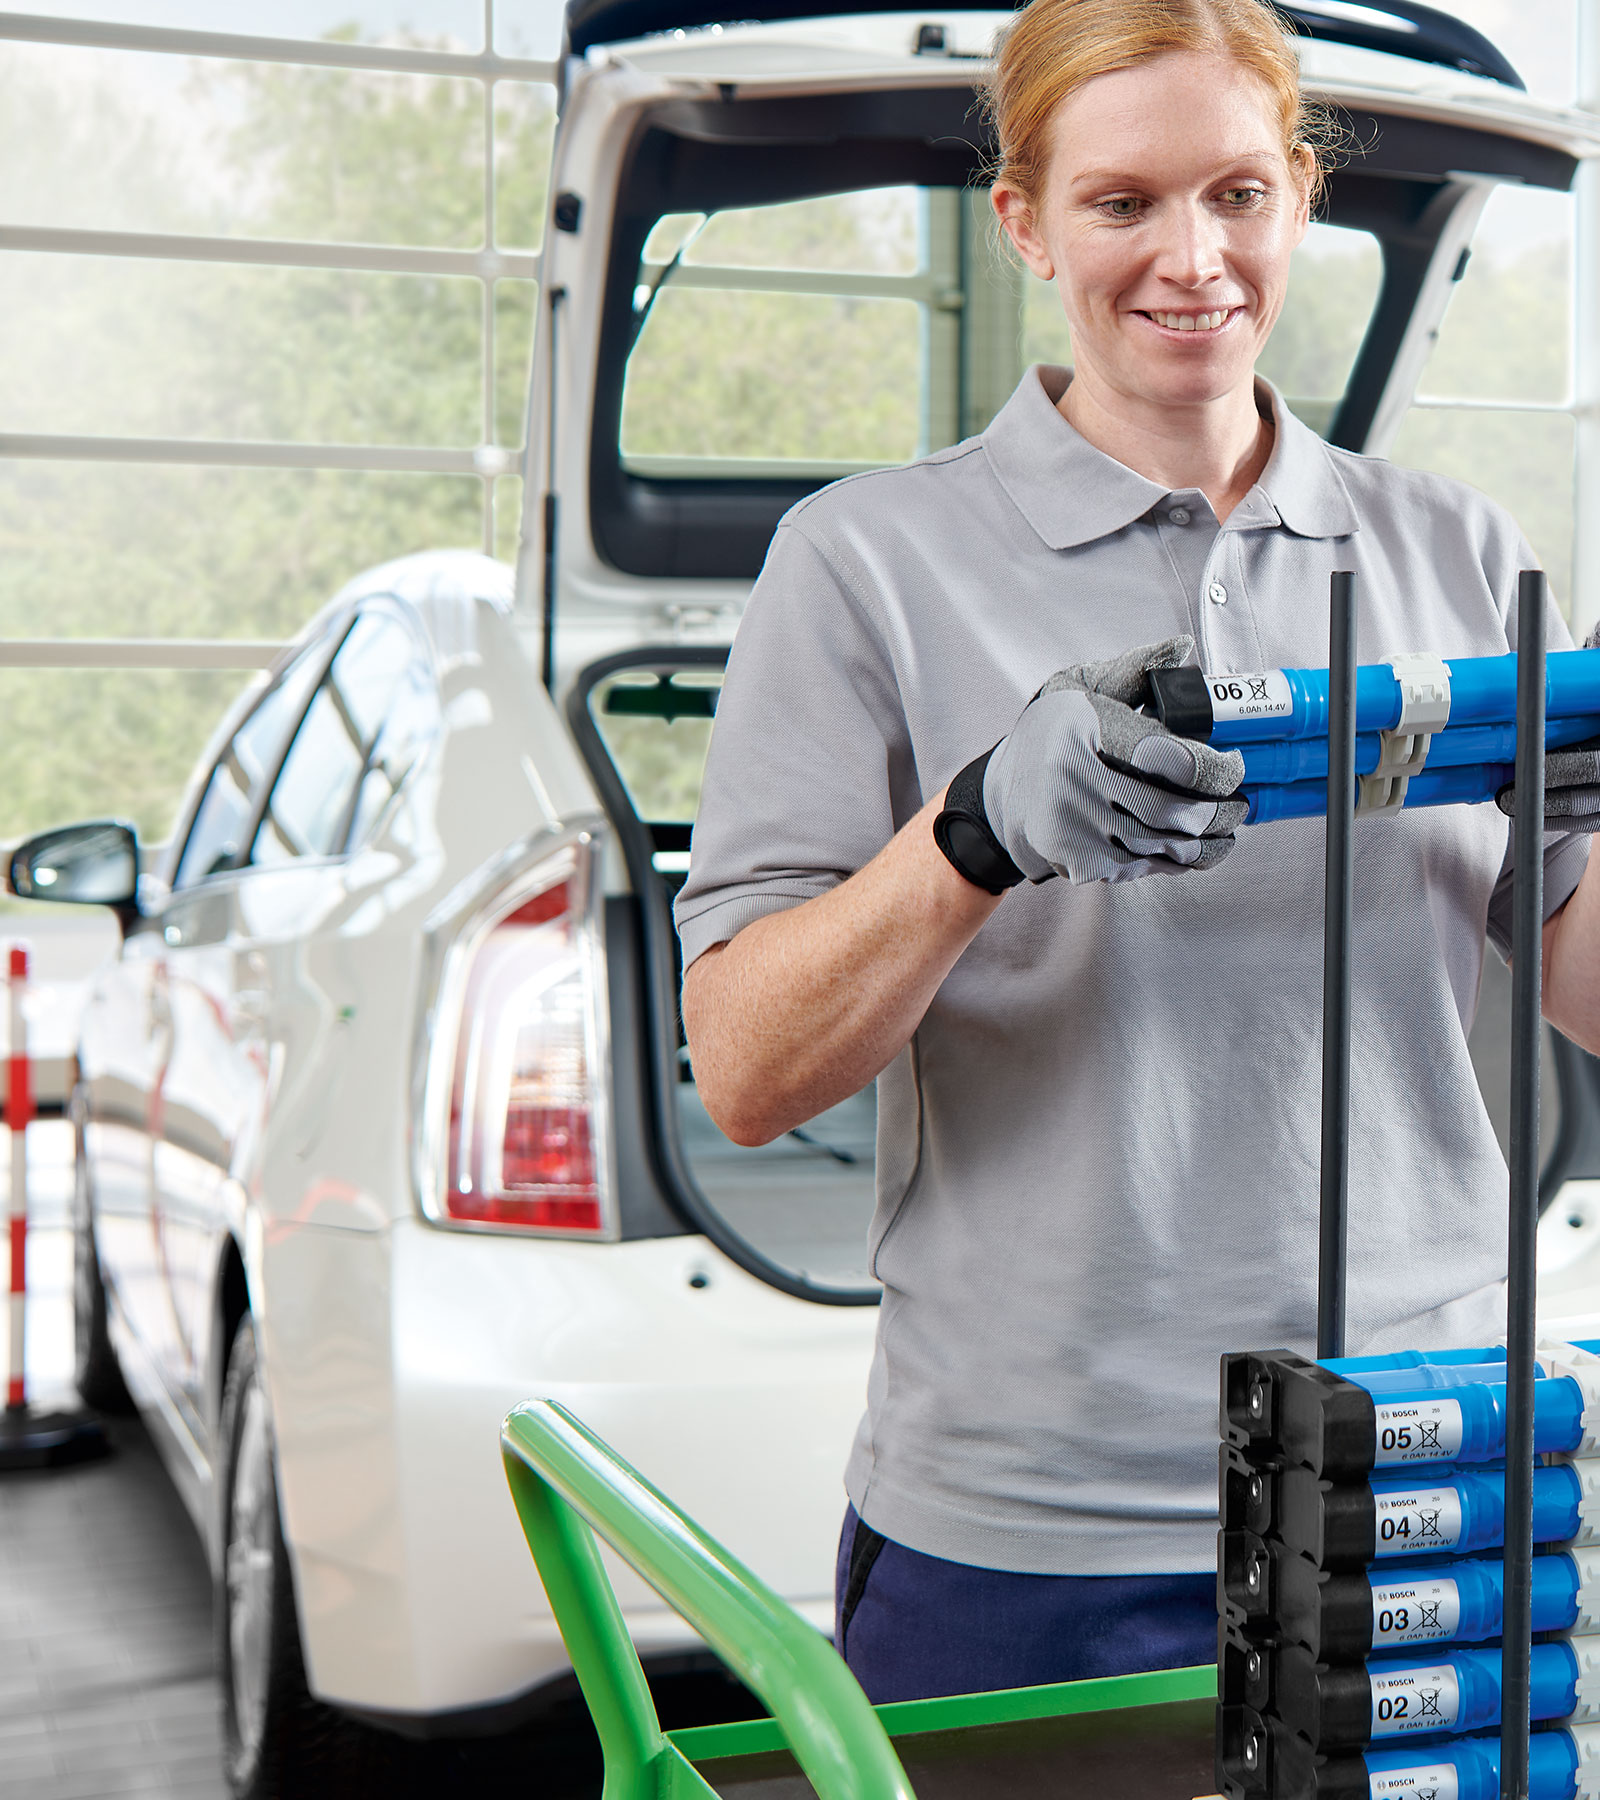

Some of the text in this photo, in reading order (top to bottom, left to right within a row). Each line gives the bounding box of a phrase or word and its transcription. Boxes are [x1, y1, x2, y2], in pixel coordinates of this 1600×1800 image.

[1213, 683, 1243, 701] 06
[1239, 703, 1286, 715] 6.0Ah 14.4V
[1392, 1409, 1418, 1418] BOSCH
[1381, 1426, 1412, 1450] 05
[1391, 1498, 1417, 1508] BOSCH
[1381, 1515, 1411, 1541] 04
[1389, 1590, 1416, 1599] BOSCH
[1379, 1608, 1409, 1632] 03
[1388, 1678, 1415, 1687] BOSCH
[1378, 1696, 1408, 1721] 02
[1388, 1778, 1415, 1788] BOSCH
